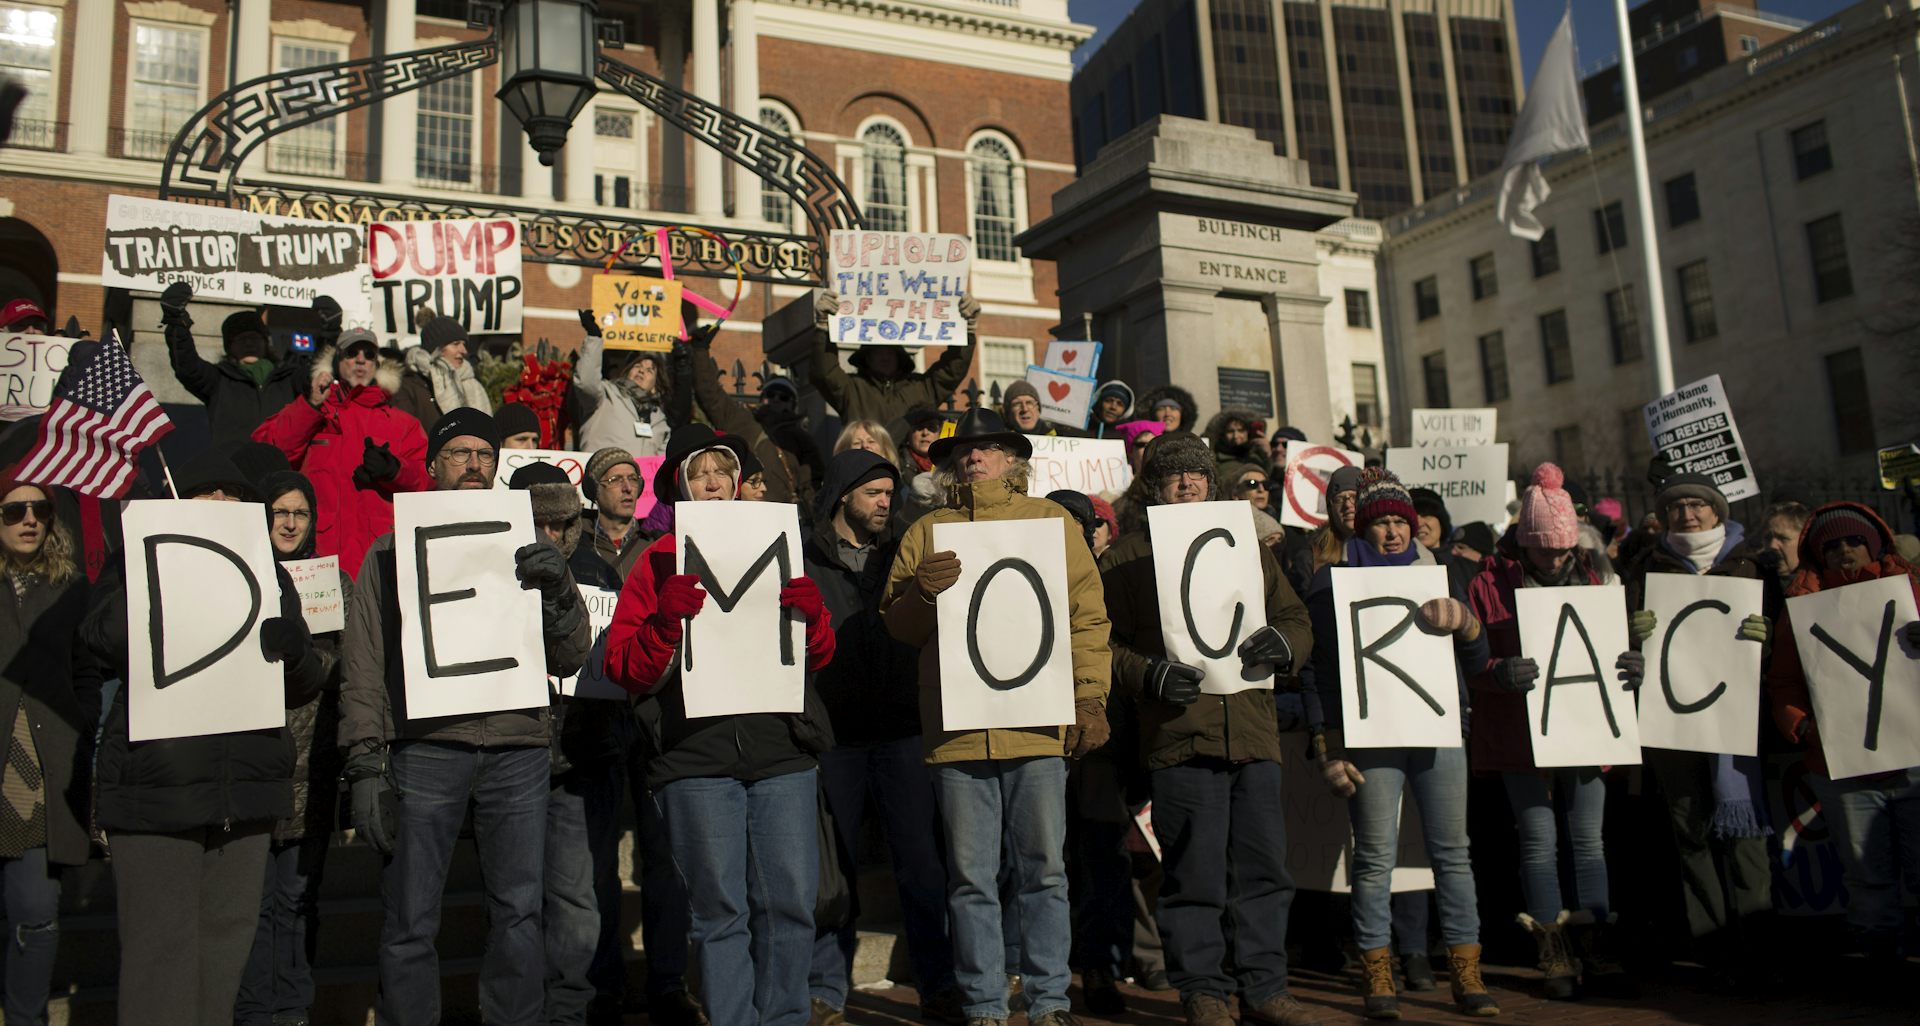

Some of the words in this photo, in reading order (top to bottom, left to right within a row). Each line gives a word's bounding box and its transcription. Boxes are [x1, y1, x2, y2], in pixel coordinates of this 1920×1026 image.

[1198, 219, 1282, 243] BULFINCH
[251, 231, 352, 268] TRUMP
[369, 220, 516, 279] DUMP
[699, 243, 812, 271] HOUSE
[833, 233, 967, 268] UPHOLD
[837, 271, 889, 297] THE
[900, 270, 964, 299] WILL
[1199, 261, 1289, 285] ENTRANCE
[372, 275, 521, 334] TRUMP
[614, 303, 662, 318] YOUR
[838, 297, 873, 316] OF
[886, 299, 951, 320] THE
[601, 328, 673, 343] ONSCIENC
[838, 317, 956, 342] PEOPLE
[1648, 405, 1658, 417] In
[1660, 397, 1675, 411] the
[1677, 384, 1708, 403] Name
[1650, 416, 1661, 428] of
[1662, 396, 1717, 424] Humanity,
[1421, 415, 1456, 432] VOTE
[1657, 431, 1675, 447] We
[1675, 415, 1726, 440] REFUSE
[1033, 438, 1080, 452] UMP
[1666, 447, 1681, 461] To
[1684, 435, 1726, 456] Accept
[1030, 456, 1123, 494] TRUMP
[1422, 453, 1468, 471] NOT
[1685, 451, 1730, 474] Fascist
